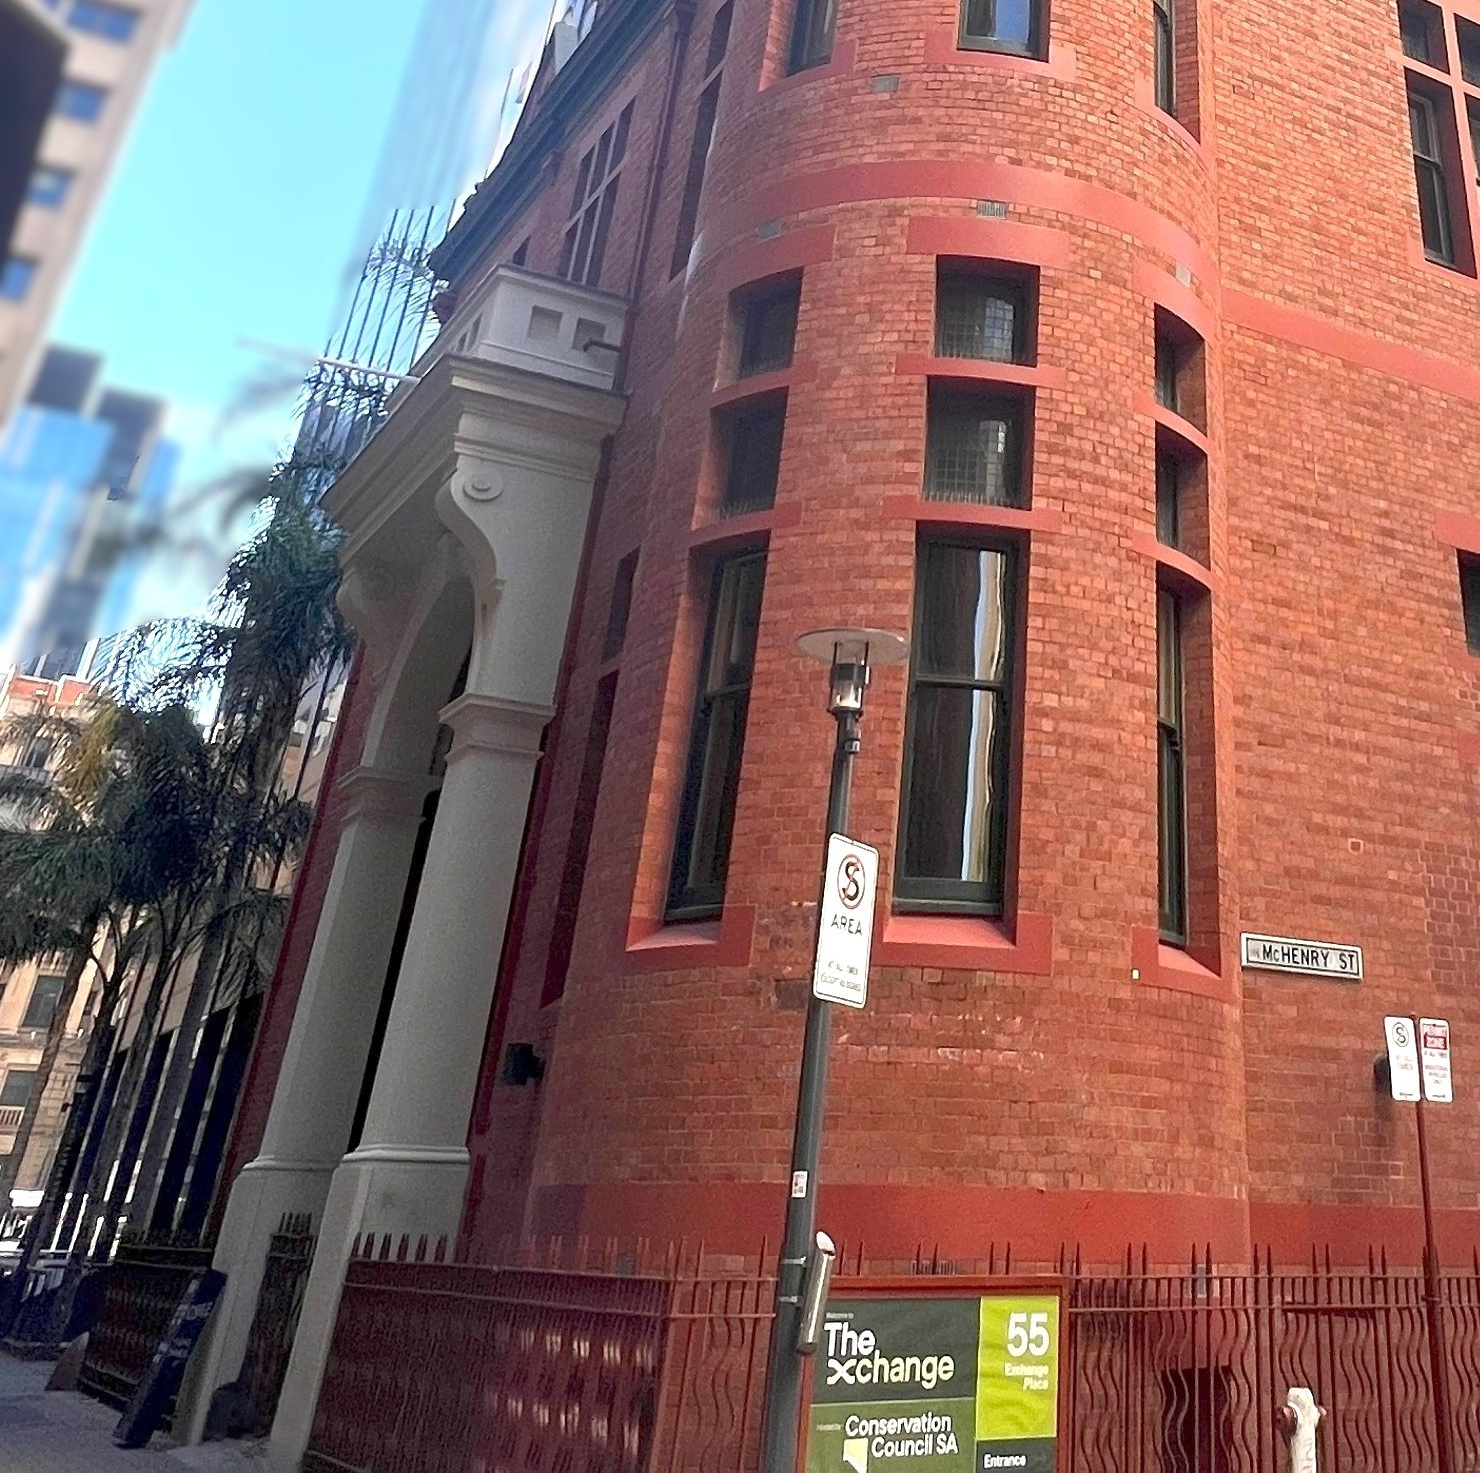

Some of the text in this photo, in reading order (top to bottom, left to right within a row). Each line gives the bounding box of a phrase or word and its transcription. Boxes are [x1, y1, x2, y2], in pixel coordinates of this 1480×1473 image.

[831, 913, 863, 936] AREA
[1262, 944, 1355, 970] McHENRY ST
[824, 1322, 876, 1357] The
[1006, 1311, 1050, 1357] 55
[1004, 1363, 1049, 1378] Exchange
[1023, 1378, 1049, 1390] Place
[845, 1411, 952, 1438] Conservation
[871, 1432, 959, 1458] Council SA
[983, 1453, 1027, 1469] Entrance
